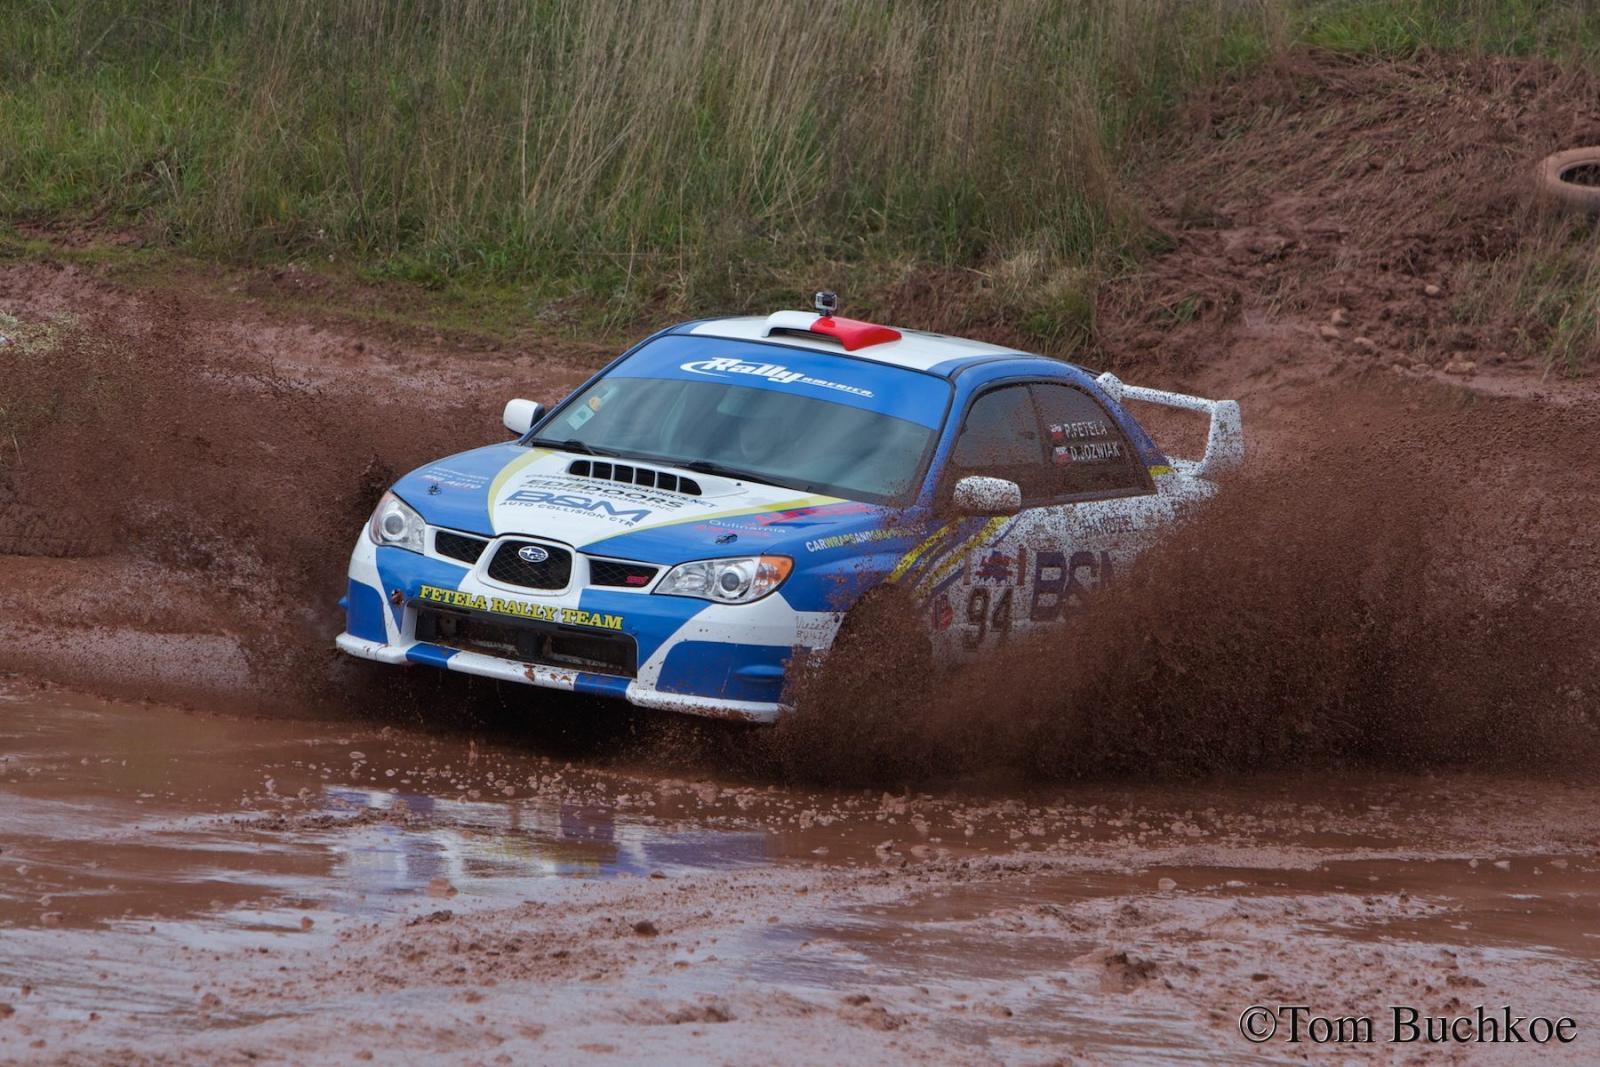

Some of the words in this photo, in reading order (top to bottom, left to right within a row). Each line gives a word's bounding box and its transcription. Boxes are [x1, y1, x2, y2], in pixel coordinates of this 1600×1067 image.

[700, 357, 804, 383] Rally
[799, 376, 873, 397] AMERICA
[537, 503, 605, 519] COLLISION
[608, 516, 635, 527] CTR
[420, 585, 486, 612] FETELA
[490, 597, 558, 621] RALLY
[561, 608, 624, 630] TEAM
[962, 584, 1015, 652] 94
